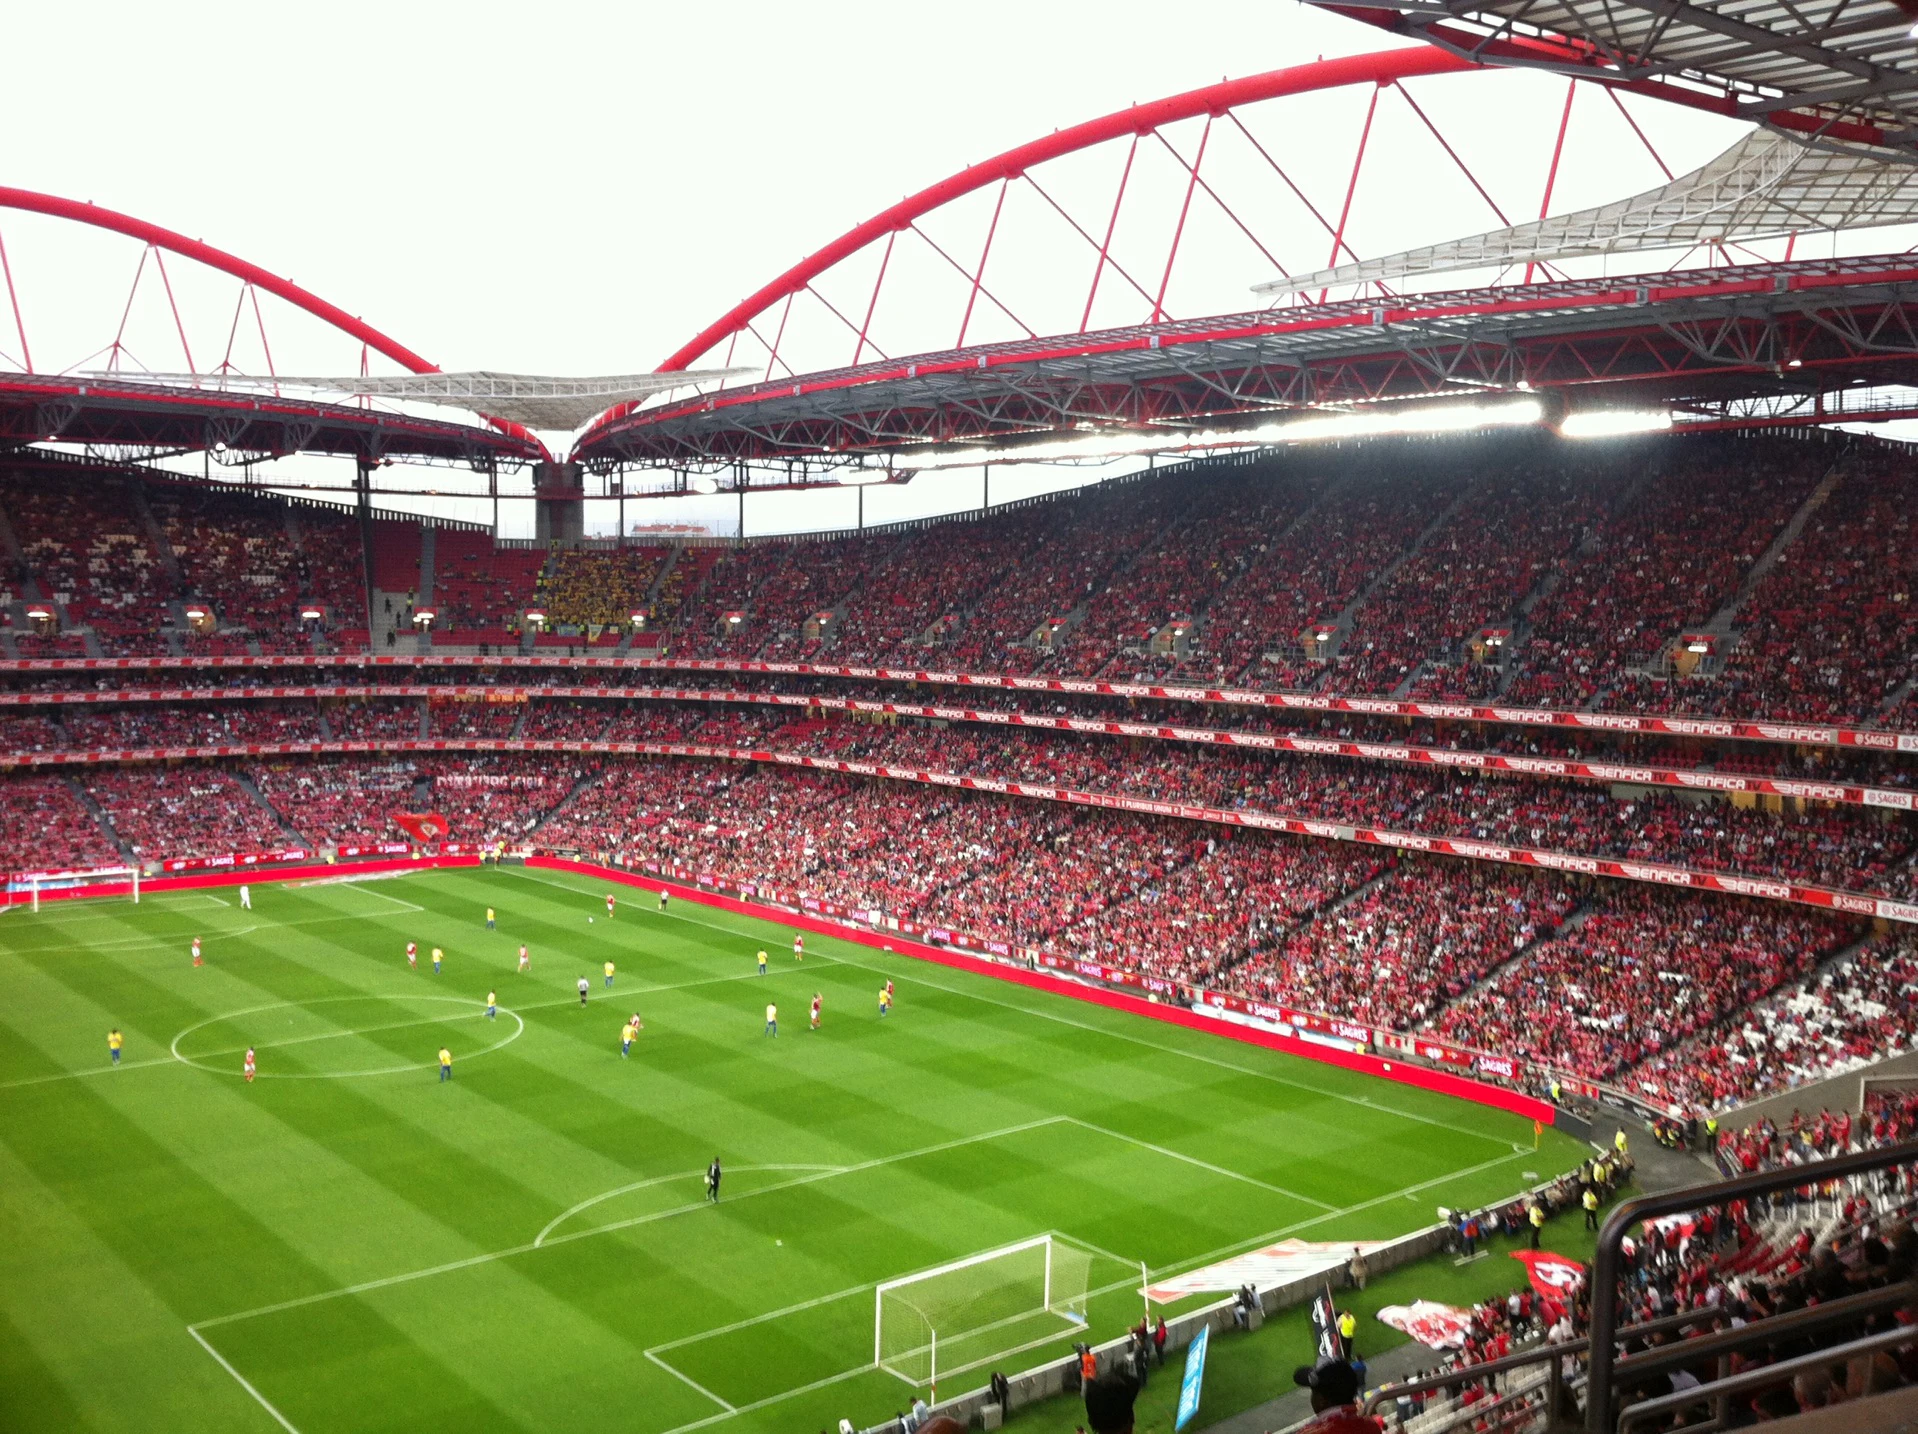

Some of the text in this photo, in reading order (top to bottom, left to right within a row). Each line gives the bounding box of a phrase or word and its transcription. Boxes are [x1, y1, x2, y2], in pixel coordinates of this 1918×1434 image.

[1220, 691, 1264, 703] BENFICA
[1347, 700, 1398, 712] BENFICA
[1417, 706, 1485, 718] BENFICA TV
[1493, 708, 1566, 723] BENFICA TV
[1576, 713, 1654, 729] BENFICA TV
[1664, 721, 1732, 735] BENFICA
[1758, 726, 1830, 741] BENFICA
[1229, 734, 1274, 746] BENFICA
[1291, 738, 1339, 752] BENFICA
[1864, 734, 1894, 747] SAGRES
[1358, 744, 1408, 758] BENFICA
[1429, 752, 1484, 766] BENFICA
[1505, 757, 1579, 774] BENFICA TV
[1588, 764, 1667, 782] BENFICA TV
[1676, 773, 1745, 790] BENFICA
[1772, 782, 1844, 798] BENFICA
[1877, 793, 1907, 806] SAGRES
[1239, 813, 1287, 829] BENFICA
[1375, 834, 1429, 849] BENFICA
[1450, 842, 1524, 861] BENFICA TV
[1532, 853, 1612, 873] BENFICA TV
[1620, 864, 1706, 886] BENFICA TV
[1716, 877, 1789, 898] BENFICA
[1842, 896, 1873, 913] SAGRES
[1254, 1006, 1281, 1021] SAGRES
[1339, 1024, 1368, 1041] SAGRES
[1479, 1056, 1513, 1077] SAGRES
